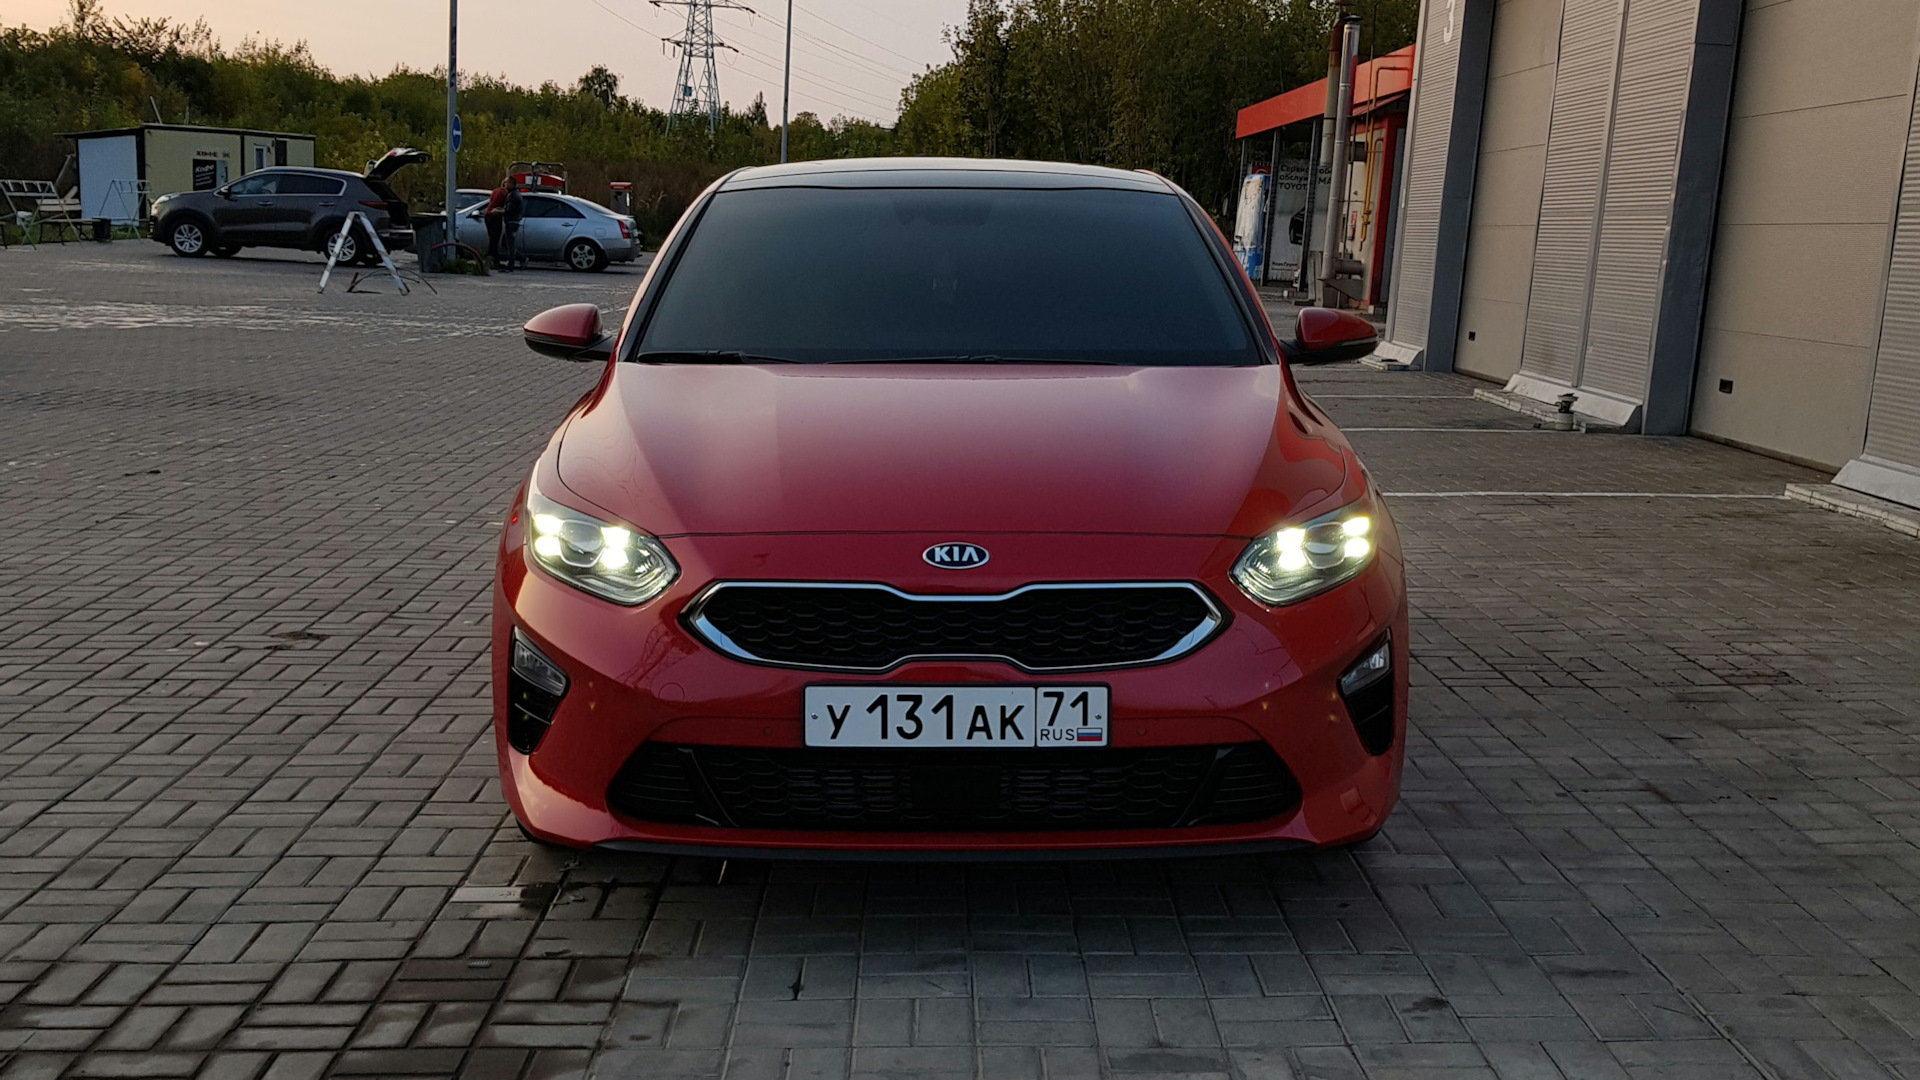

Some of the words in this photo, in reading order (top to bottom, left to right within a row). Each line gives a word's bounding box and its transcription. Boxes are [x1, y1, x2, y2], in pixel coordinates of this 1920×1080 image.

[1279, 182, 1307, 190] TOYOT
[934, 546, 979, 562] KIA
[1042, 691, 1089, 727] 71
[1040, 728, 1075, 741] RUS
